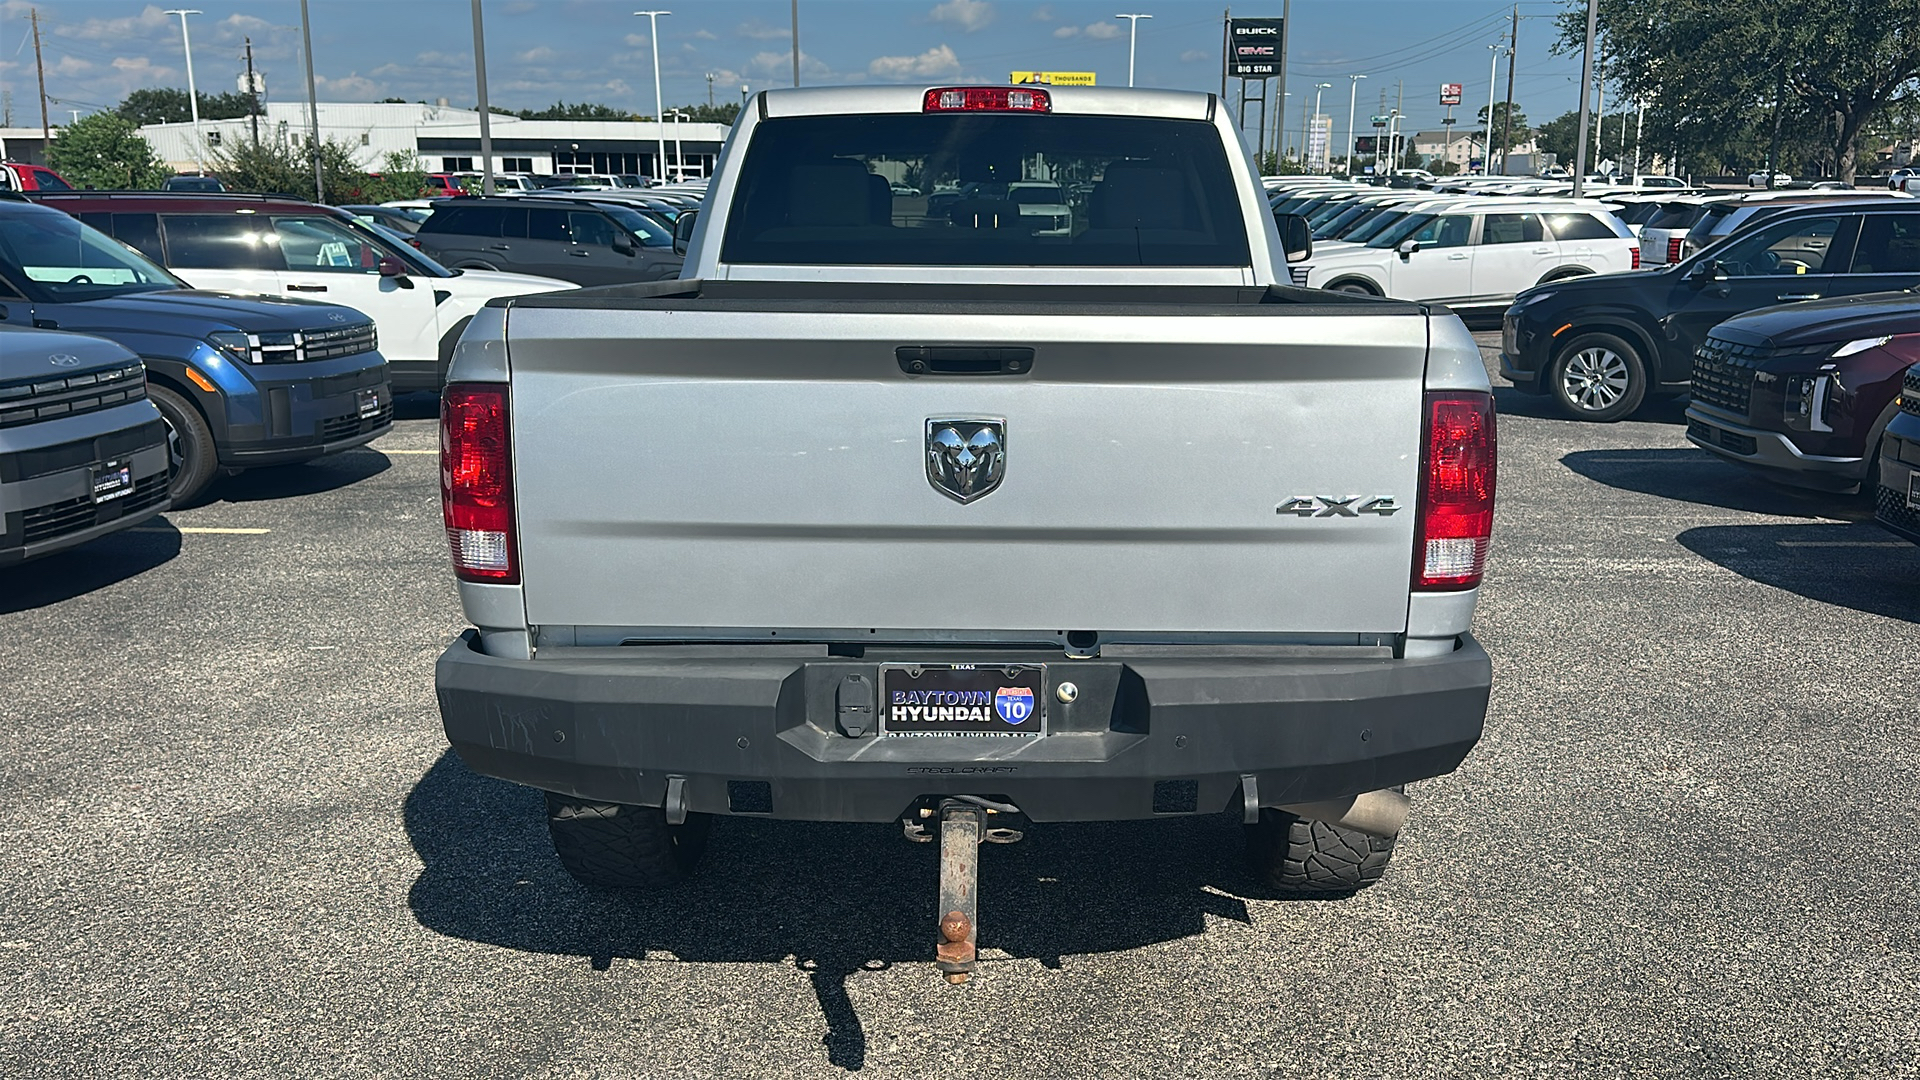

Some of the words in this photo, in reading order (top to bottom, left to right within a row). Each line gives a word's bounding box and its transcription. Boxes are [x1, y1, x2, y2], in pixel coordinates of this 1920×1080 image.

[1238, 46, 1274, 55] GMC
[1237, 65, 1251, 73] BIG
[1253, 65, 1272, 73] STAR
[892, 691, 991, 705] BAYTOWN
[891, 706, 991, 721] HYUNDAI
[1003, 702, 1026, 719] 10
